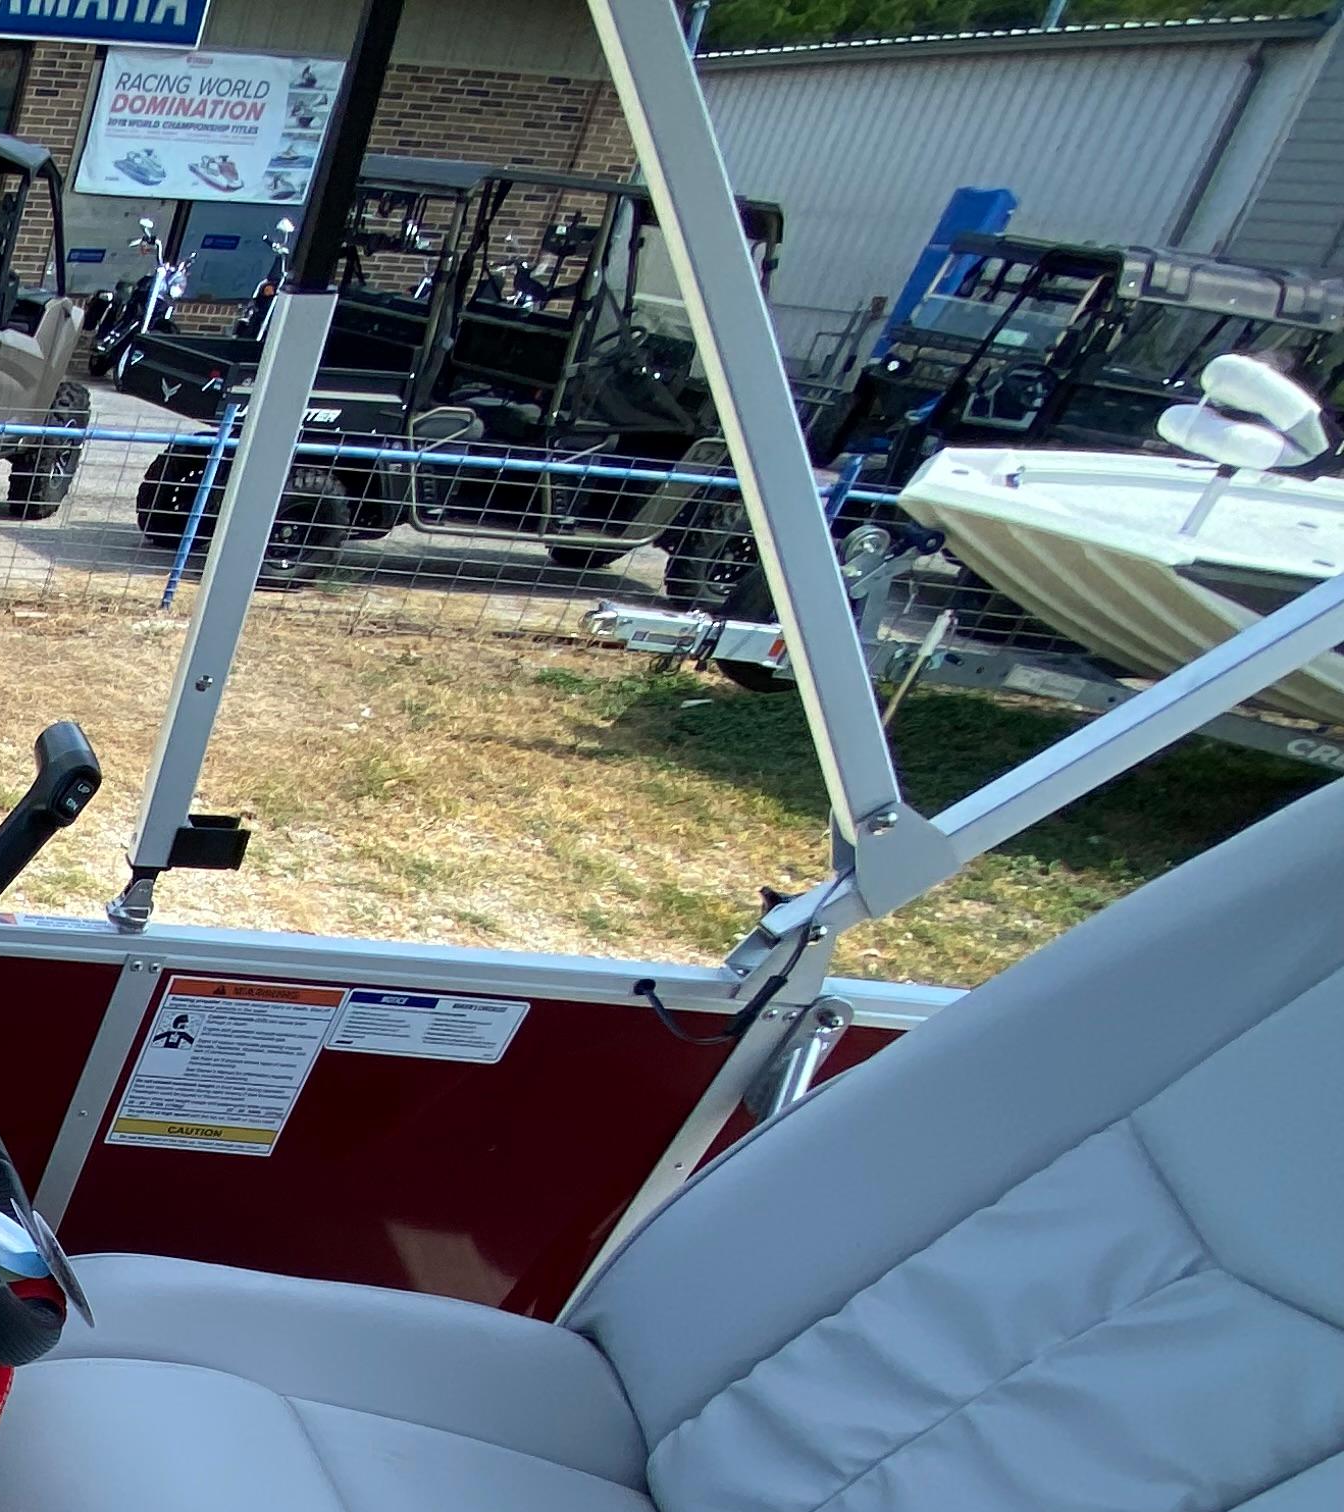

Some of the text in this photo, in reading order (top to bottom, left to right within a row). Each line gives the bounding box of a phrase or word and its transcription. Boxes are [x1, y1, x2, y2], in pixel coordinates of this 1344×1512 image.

[115, 71, 270, 99] RACING WORLD
[110, 93, 267, 121] DOMINATION
[128, 119, 160, 129] WORLD
[162, 121, 231, 132] CHAMPIONSHIP
[231, 124, 259, 135] TITLES
[167, 1126, 224, 1138] CAUTION
